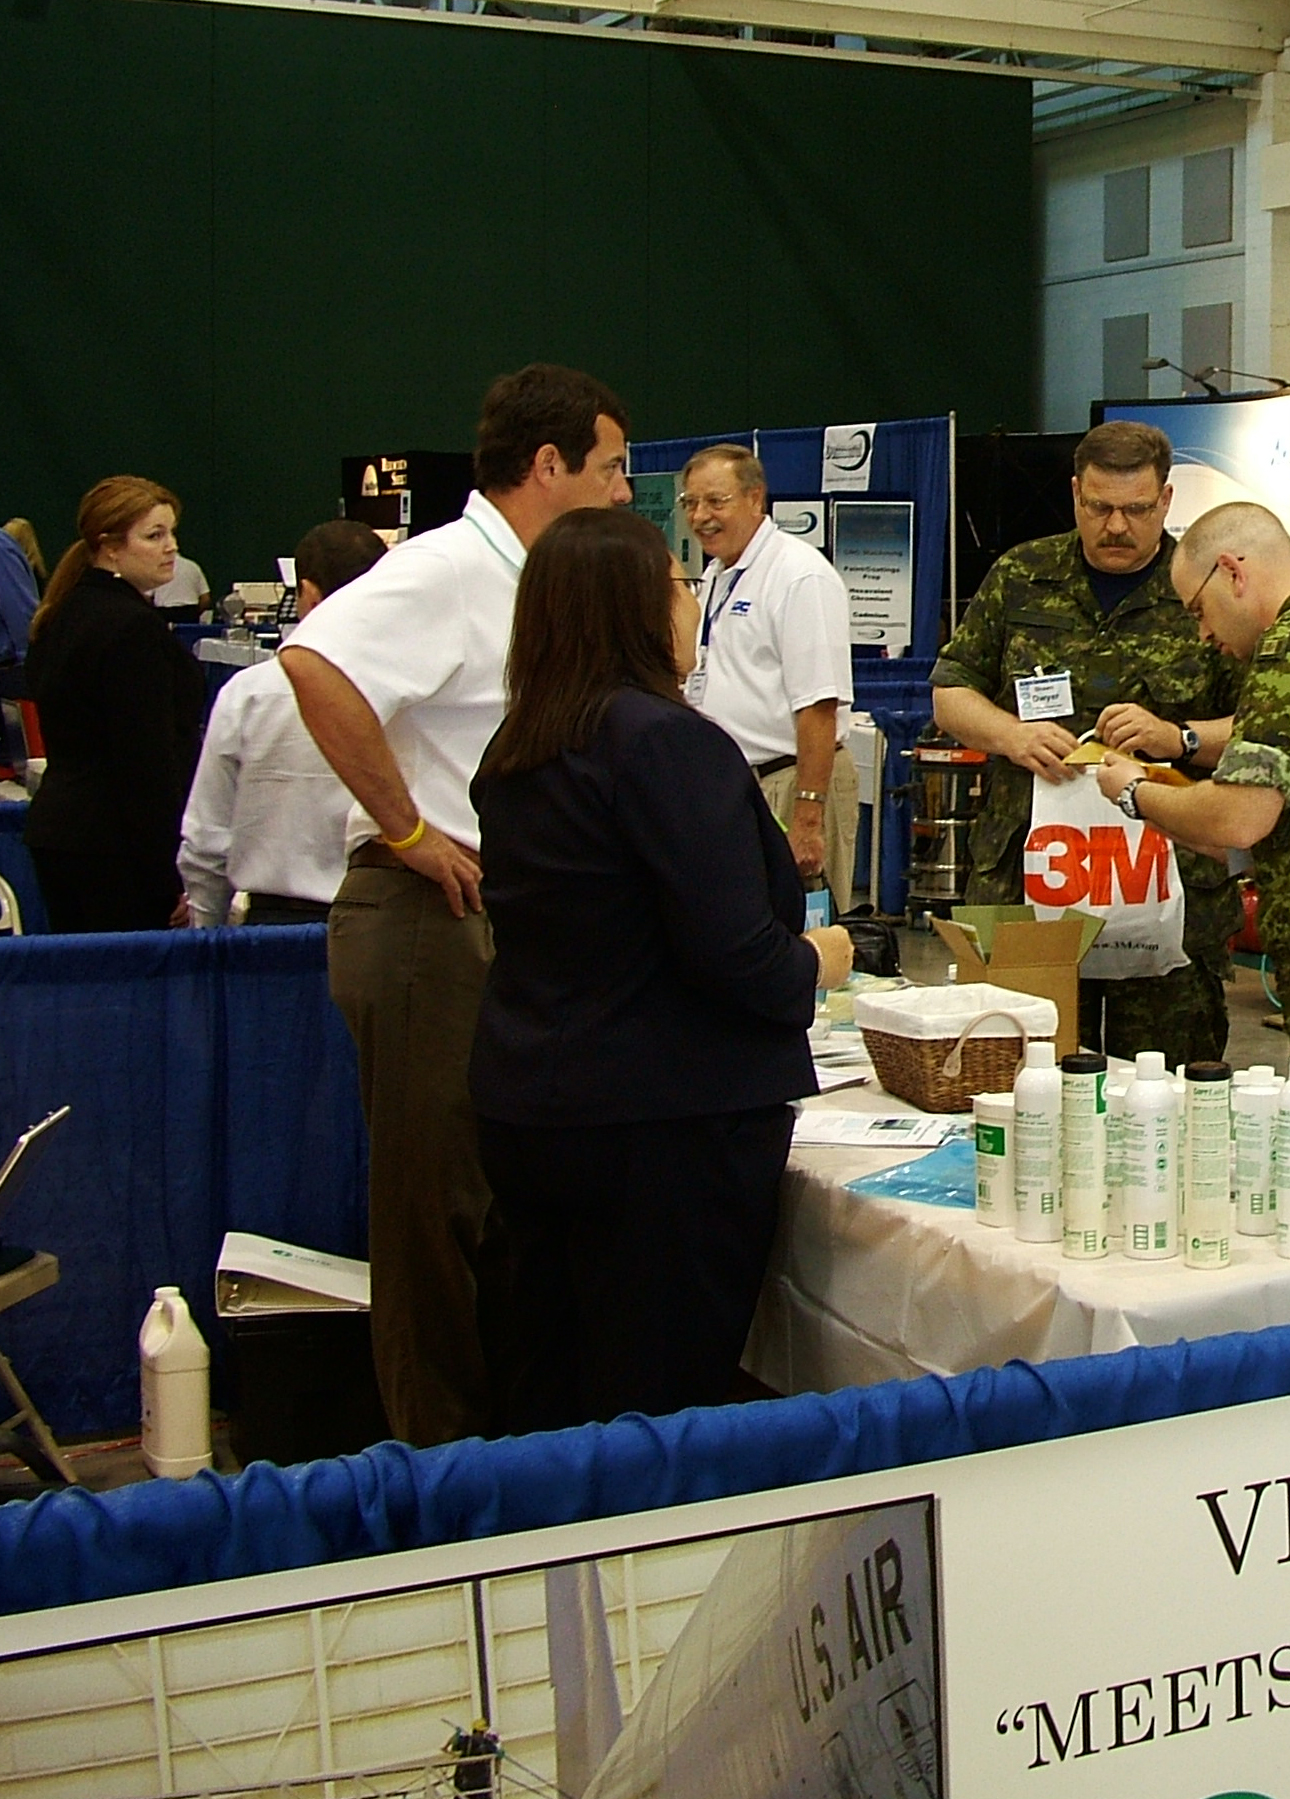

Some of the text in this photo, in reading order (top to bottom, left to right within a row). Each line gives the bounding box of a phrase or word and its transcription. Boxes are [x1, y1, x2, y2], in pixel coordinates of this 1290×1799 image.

[1024, 824, 1171, 908] 3M
[788, 1538, 913, 1724] U.S. AIR
